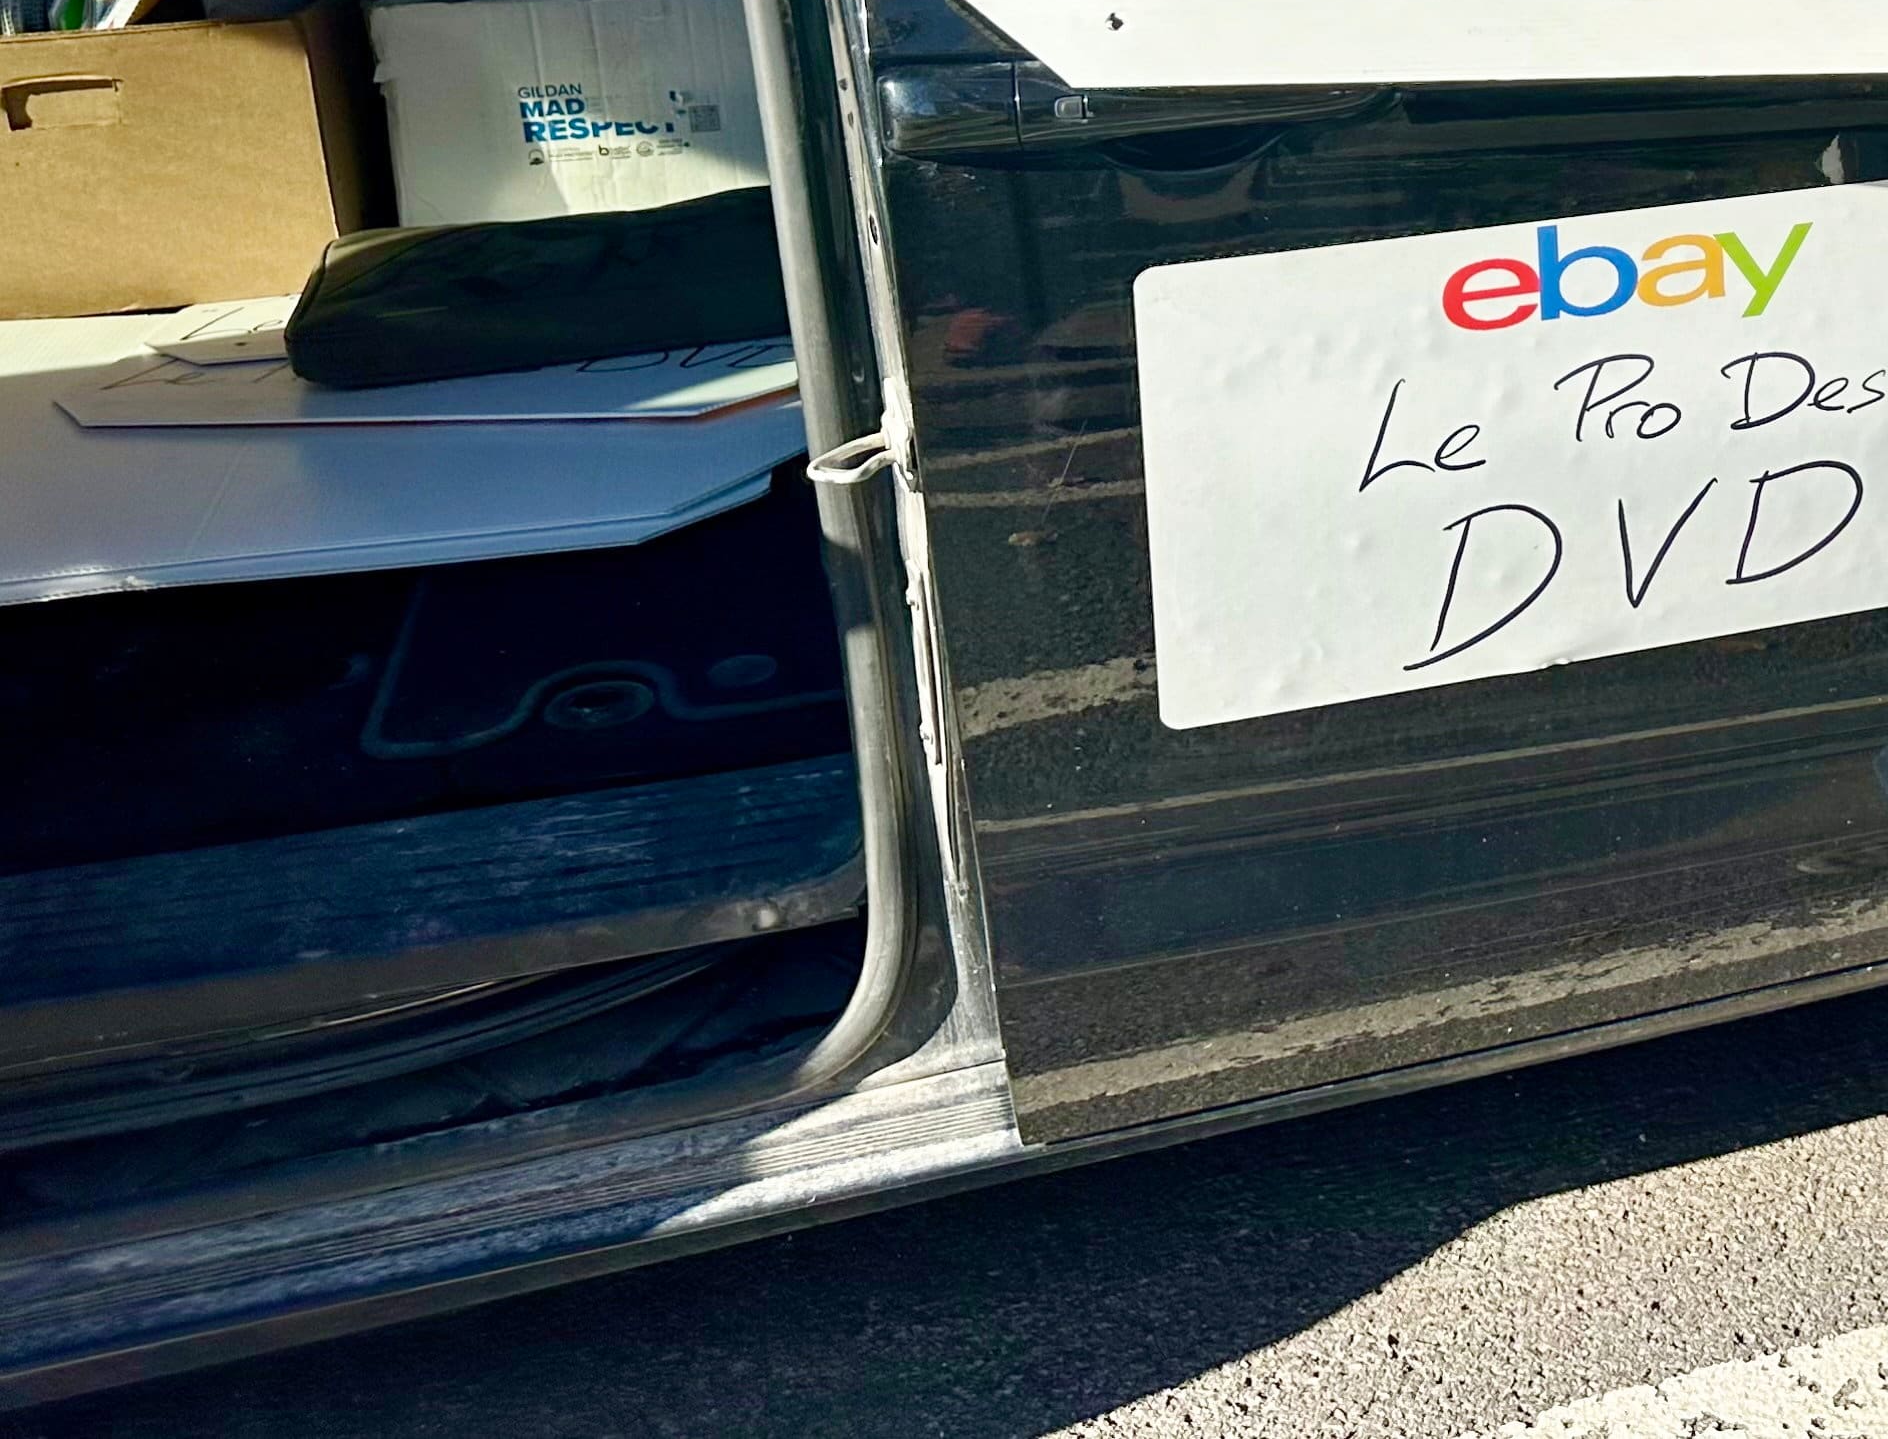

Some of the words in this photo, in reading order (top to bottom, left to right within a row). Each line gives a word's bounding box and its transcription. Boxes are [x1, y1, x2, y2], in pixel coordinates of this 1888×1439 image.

[518, 83, 583, 99] GILDAN
[519, 97, 586, 119] MAD
[1442, 222, 1812, 331] ebay
[1358, 378, 1487, 493] Le
[1553, 352, 1683, 443] Pro
[1719, 350, 1887, 432] Des
[1402, 460, 1865, 672] DVD
